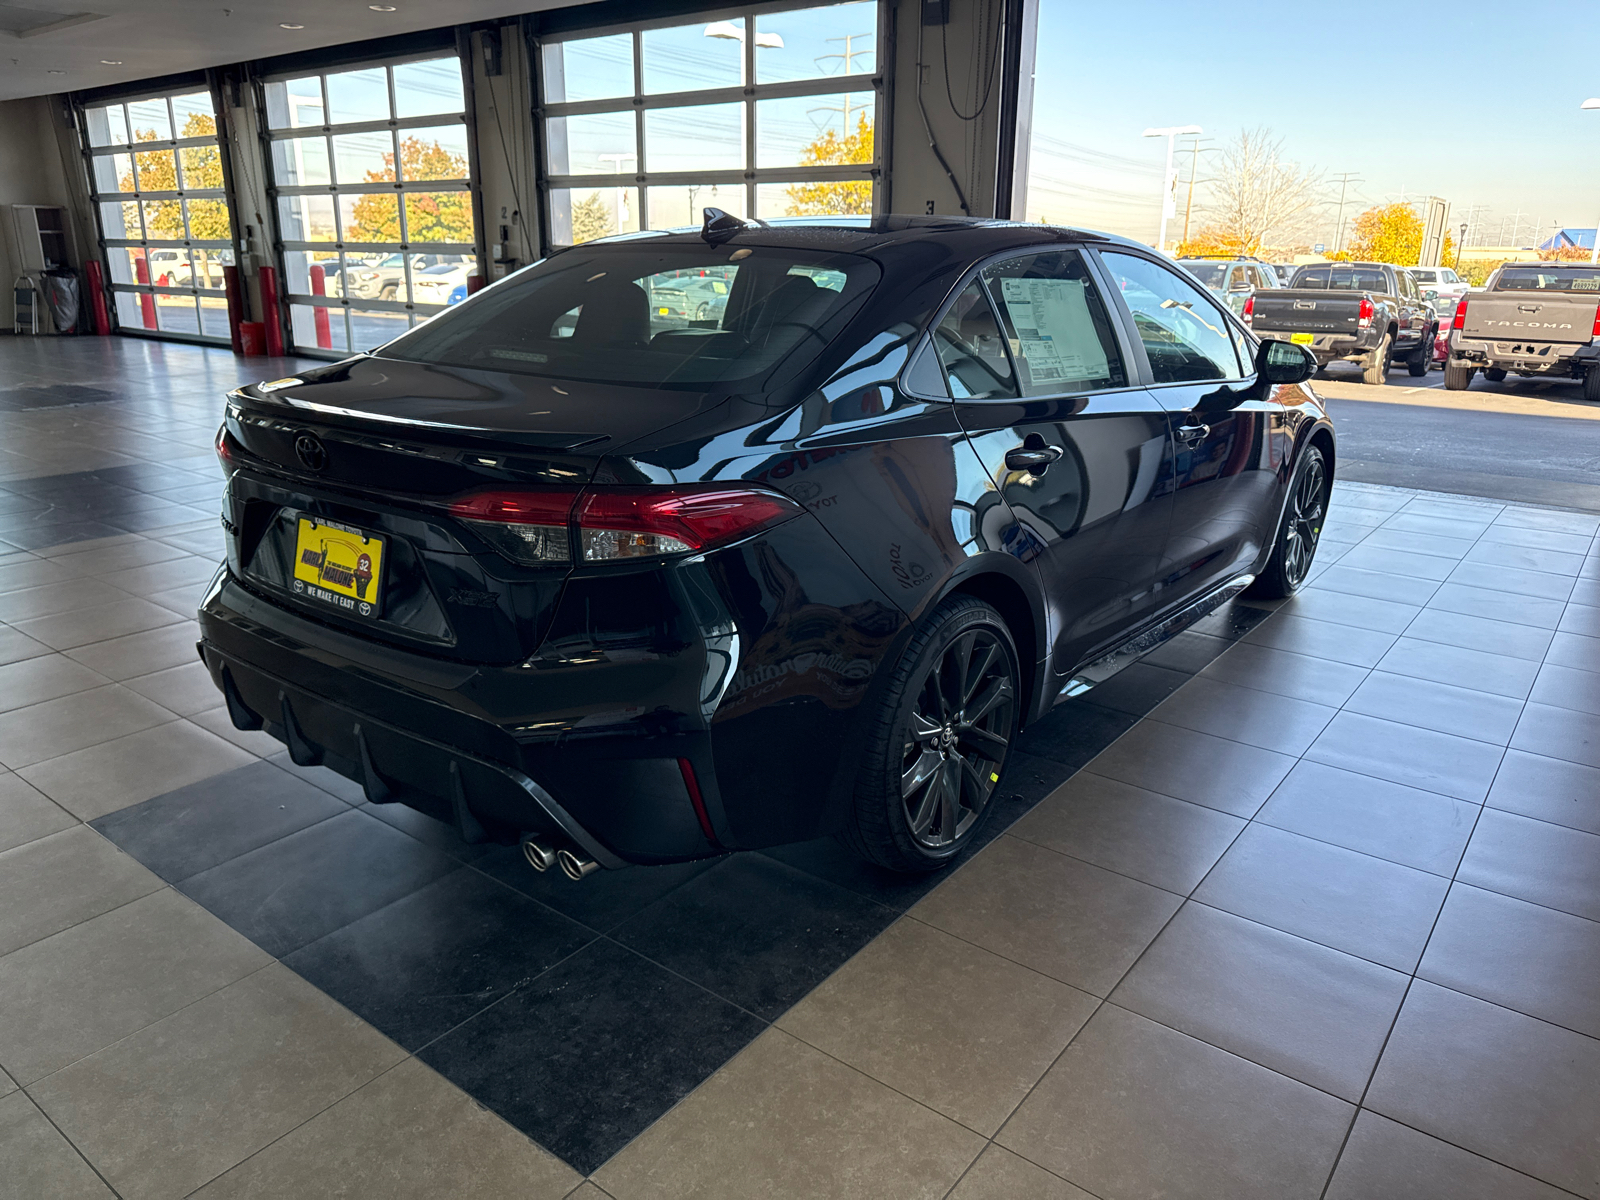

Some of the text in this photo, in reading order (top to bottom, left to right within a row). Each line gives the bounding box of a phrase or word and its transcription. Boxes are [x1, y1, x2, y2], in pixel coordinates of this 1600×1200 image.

[501, 206, 508, 219] 2
[926, 200, 935, 215] 3
[1484, 320, 1572, 329] TACOMA
[301, 549, 321, 568] KARL
[360, 559, 370, 572] 32
[322, 565, 355, 589] MALONE
[307, 586, 355, 610] WE MAKE IT EASY
